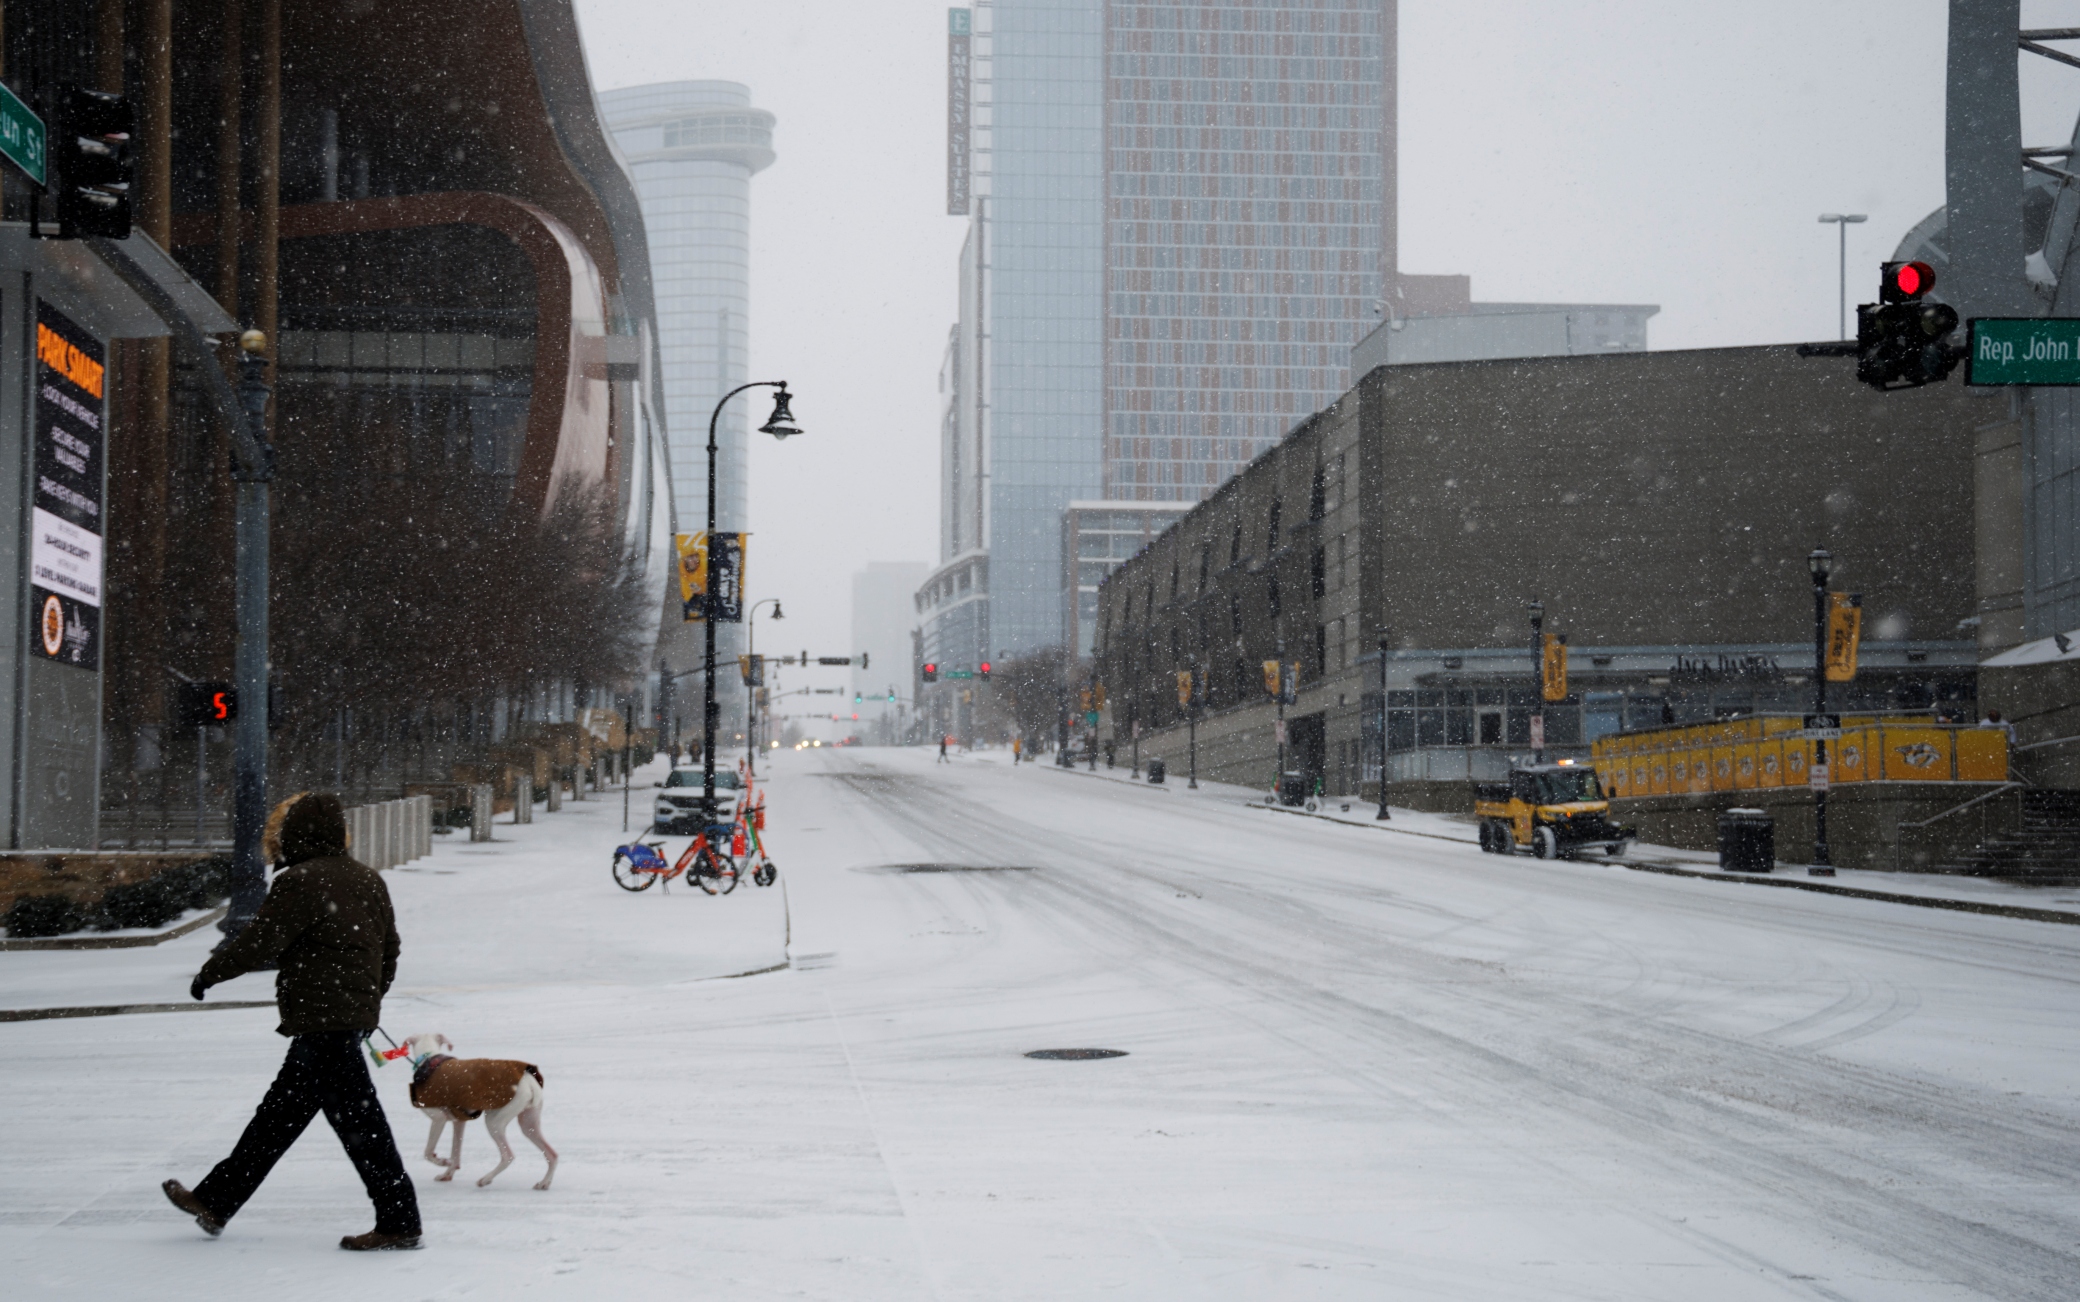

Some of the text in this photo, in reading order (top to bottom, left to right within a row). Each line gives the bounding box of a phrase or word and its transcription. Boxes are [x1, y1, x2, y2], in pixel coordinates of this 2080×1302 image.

[952, 44, 967, 200] EMBASSY SUITES
[26, 127, 42, 166] St
[37, 322, 105, 399] PARK SMART
[2022, 336, 2069, 361] John
[1669, 654, 1712, 677] JACK
[213, 692, 227, 719] 5
